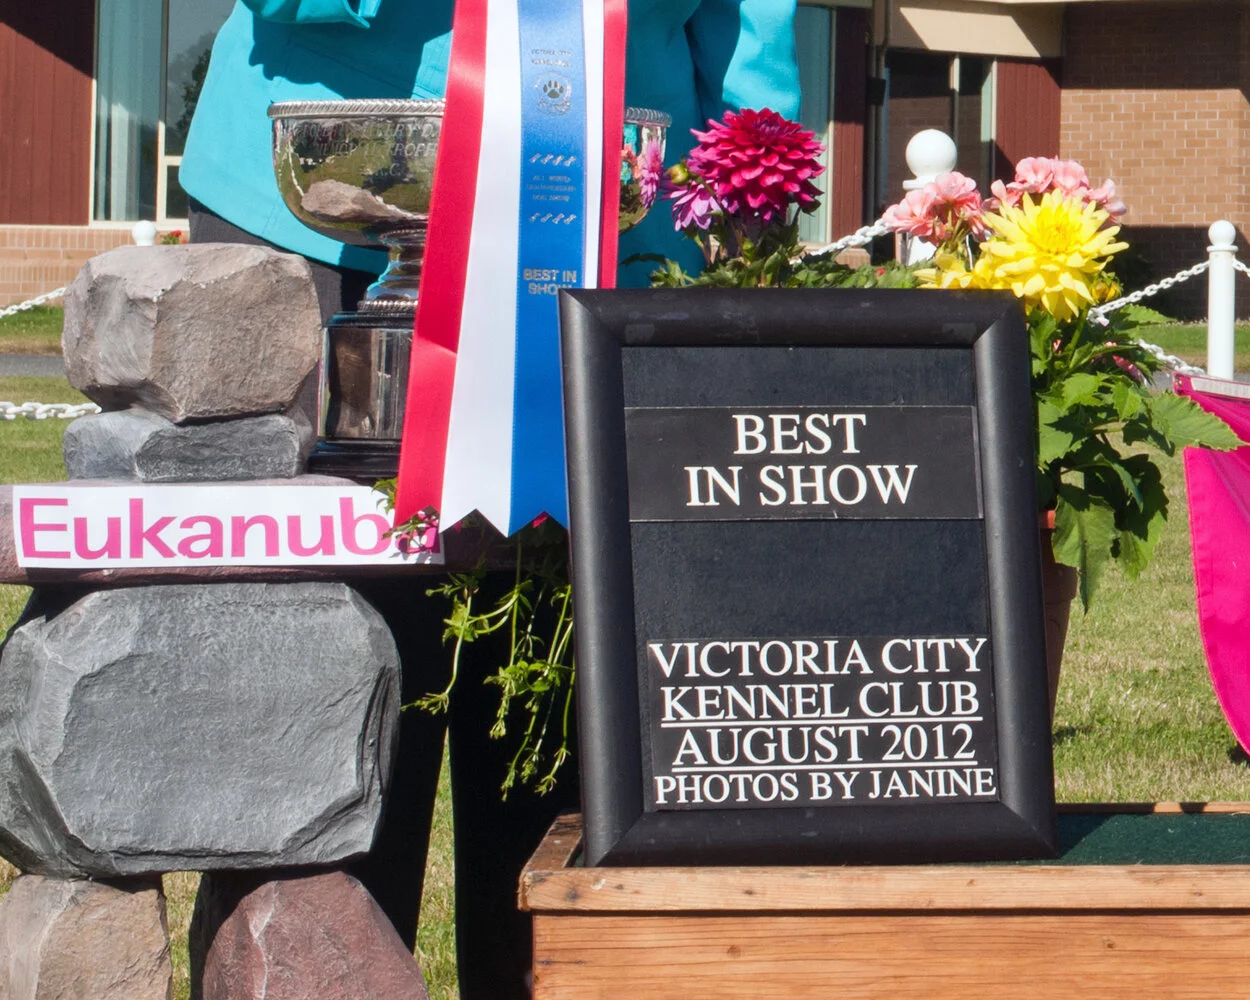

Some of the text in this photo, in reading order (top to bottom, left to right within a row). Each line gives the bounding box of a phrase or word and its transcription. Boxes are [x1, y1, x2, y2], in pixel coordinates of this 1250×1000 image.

[524, 268, 577, 283] BEST IN
[731, 413, 867, 454] BEST
[684, 464, 918, 506] IN SHOW
[649, 638, 987, 678] VICTORIA CITY
[660, 681, 980, 720] KENNEL CLUB
[672, 723, 976, 765] AUGUST 2012
[654, 768, 997, 804] PHOTOS BY JANINE
